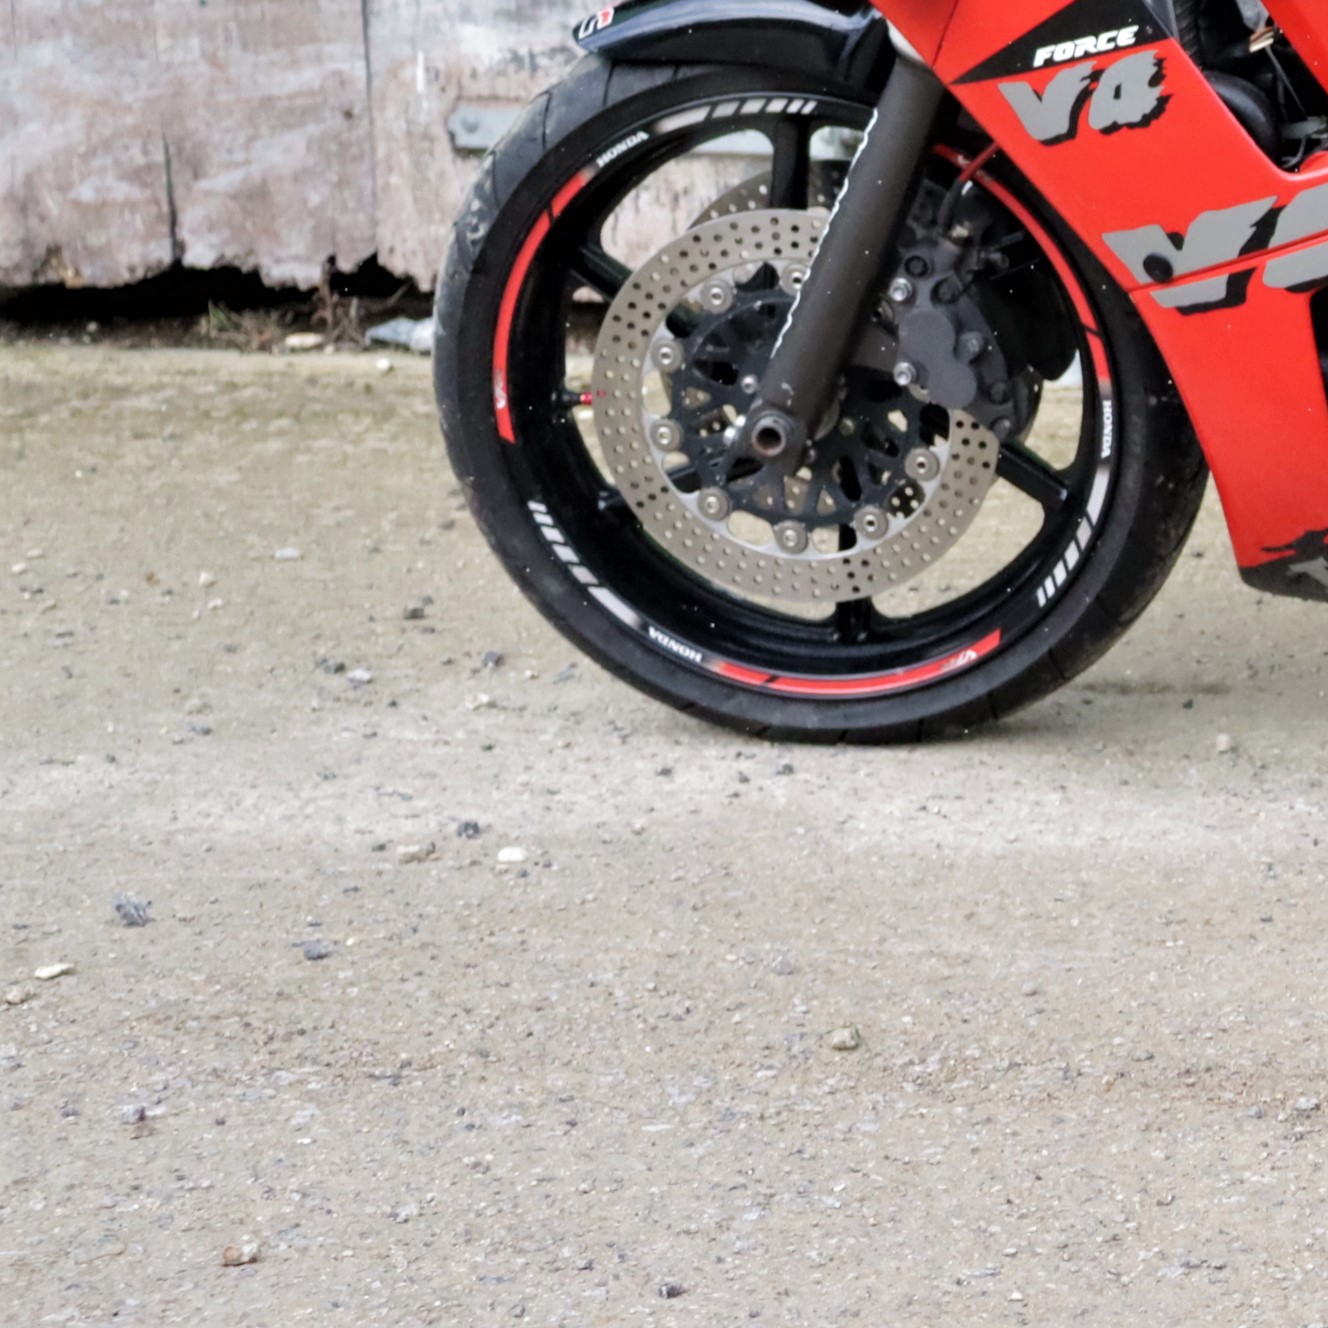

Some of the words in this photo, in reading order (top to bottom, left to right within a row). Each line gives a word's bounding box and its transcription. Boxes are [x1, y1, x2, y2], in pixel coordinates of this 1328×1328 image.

[1032, 25, 1139, 68] FORCE
[997, 49, 1174, 146] V4
[595, 130, 650, 168] HONDA
[1101, 399, 1113, 460] HONDA
[648, 625, 703, 665] HONDA
